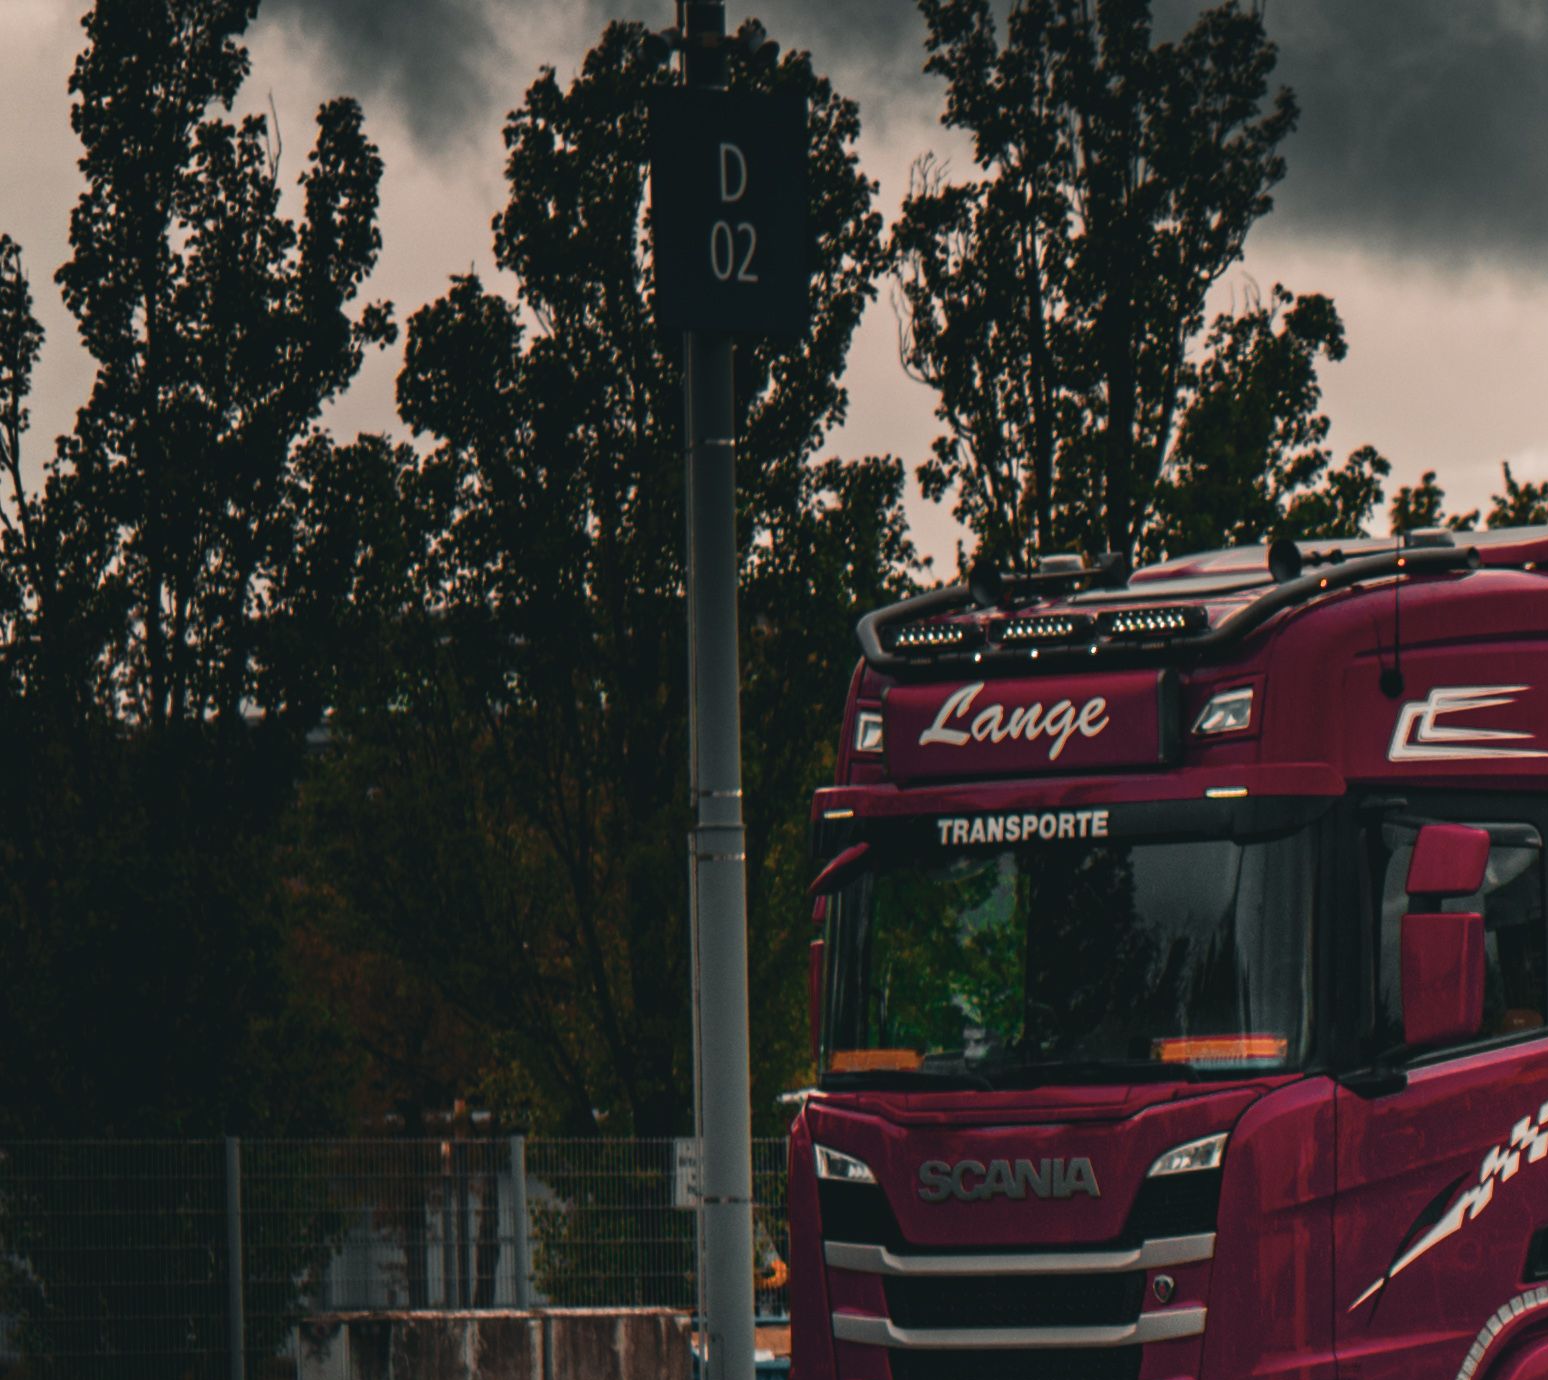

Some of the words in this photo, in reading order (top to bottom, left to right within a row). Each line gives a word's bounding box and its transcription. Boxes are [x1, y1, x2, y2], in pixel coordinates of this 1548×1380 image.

[719, 142, 748, 202] D
[710, 220, 759, 282] 02
[918, 680, 1110, 761] Lange
[937, 809, 1109, 846] TRANSPORTE
[917, 1156, 1101, 1202] SCANIA
